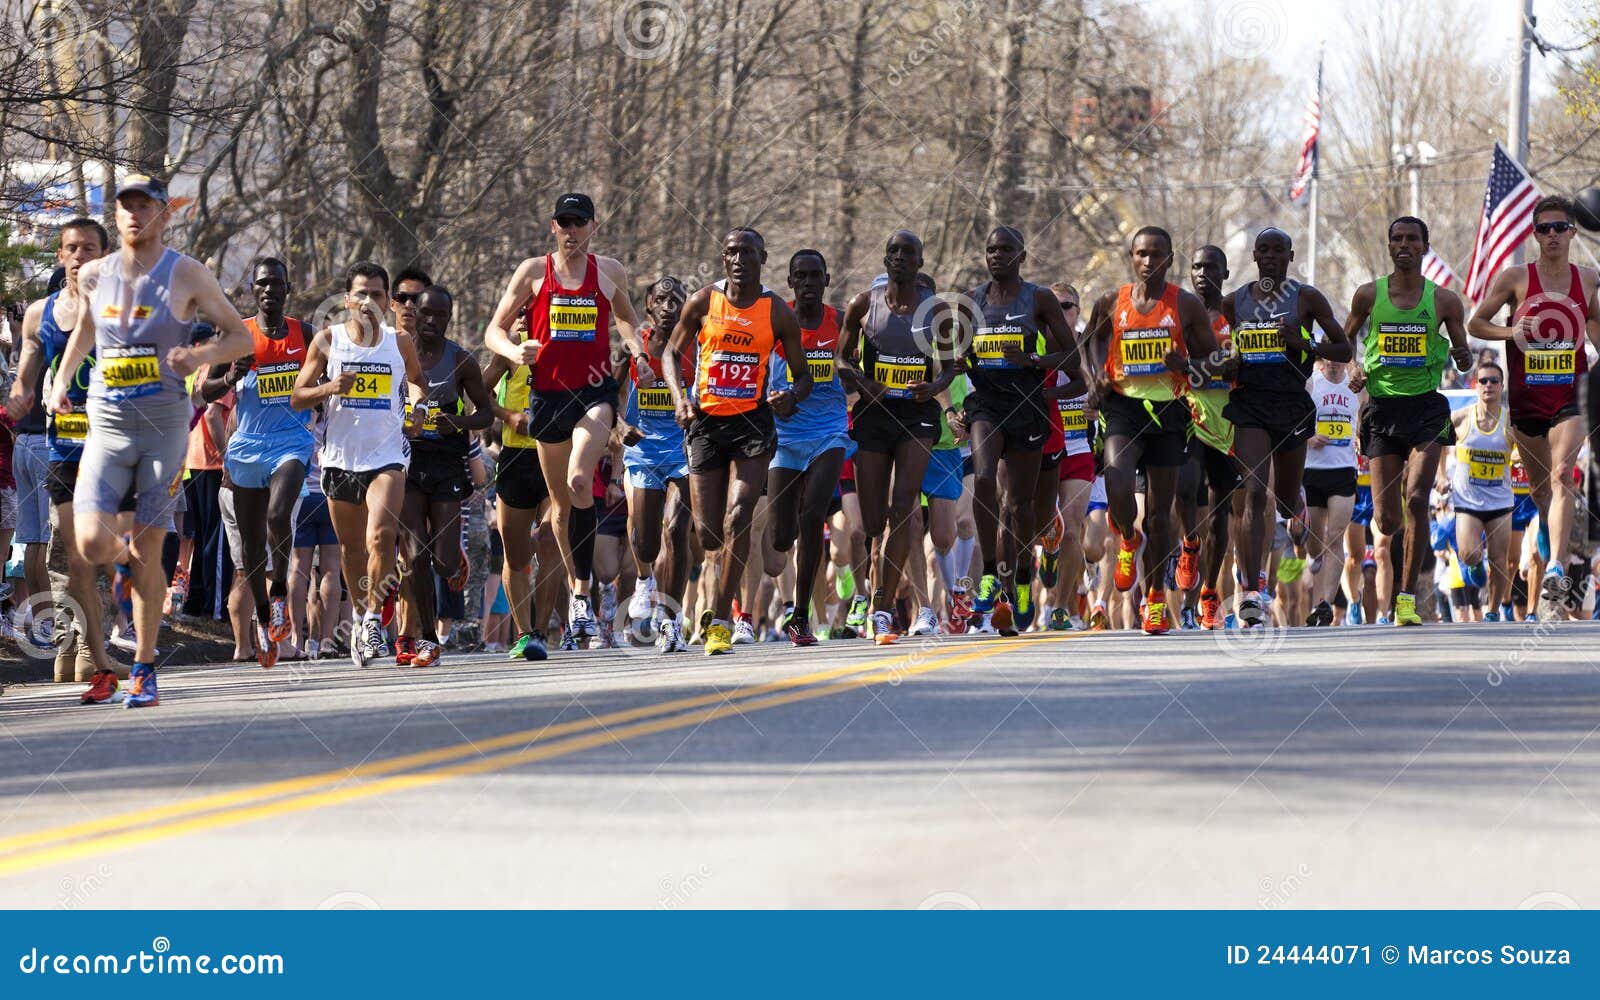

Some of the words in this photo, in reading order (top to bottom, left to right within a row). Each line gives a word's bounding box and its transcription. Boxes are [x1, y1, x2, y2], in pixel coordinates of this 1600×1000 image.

[1140, 328, 1169, 338] adidas
[1399, 325, 1426, 333] adidas
[722, 333, 752, 346] RUN
[1384, 336, 1421, 353] GEBRE
[1546, 341, 1574, 349] adidas
[730, 354, 758, 363] adidas
[807, 350, 833, 358] adidas
[897, 356, 925, 364] adidas
[1528, 354, 1572, 370] BUTTER
[361, 365, 391, 373] adidas
[720, 364, 751, 381] 192
[877, 367, 888, 382] W
[355, 376, 378, 393] 84
[640, 392, 674, 406] CHUM
[1322, 393, 1349, 408] NYAC
[1328, 424, 1344, 436] 39
[1480, 465, 1495, 477] 31
